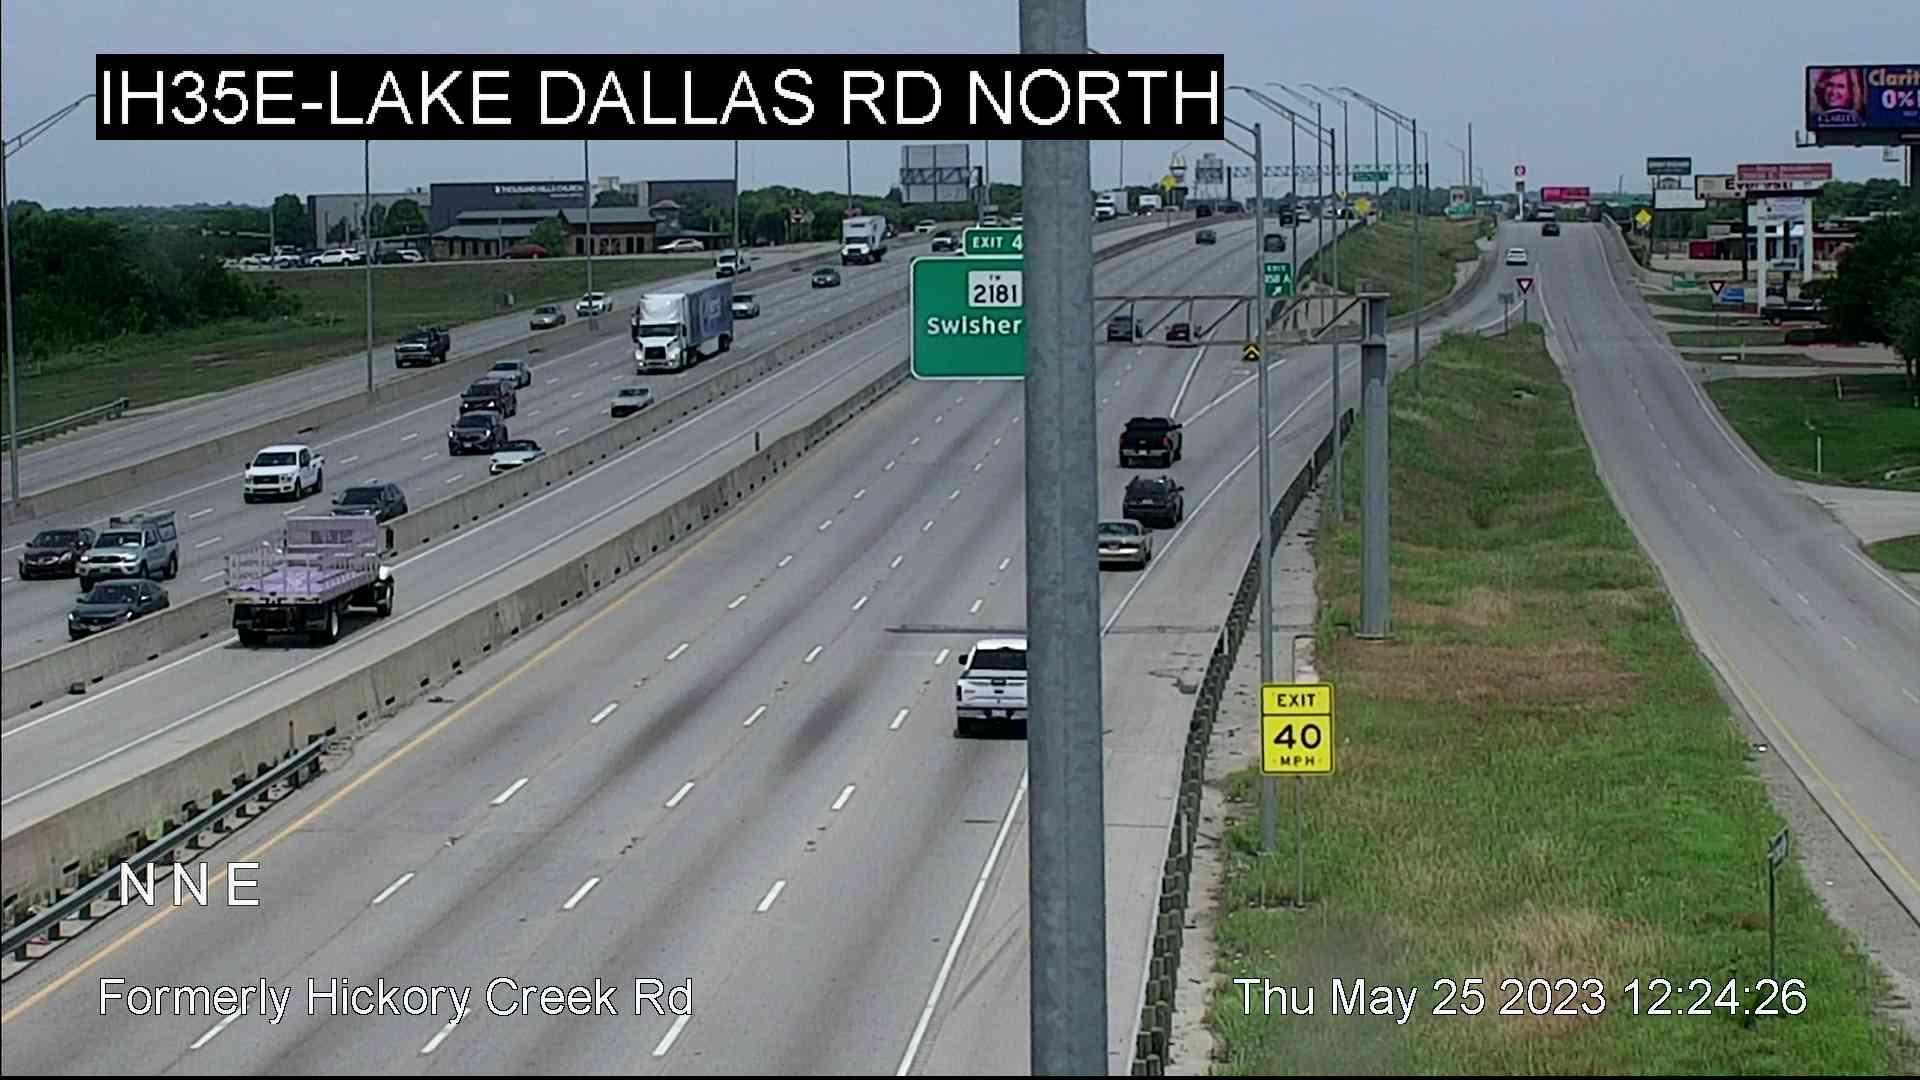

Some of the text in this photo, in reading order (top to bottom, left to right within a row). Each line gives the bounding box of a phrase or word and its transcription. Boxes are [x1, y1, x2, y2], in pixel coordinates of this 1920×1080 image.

[972, 236, 1003, 249] EXIT
[973, 284, 1018, 304] 2181
[927, 315, 1023, 336] Swisher
[1277, 693, 1316, 707] EXIT
[1273, 723, 1322, 750] 40
[1280, 756, 1316, 767] MPH
